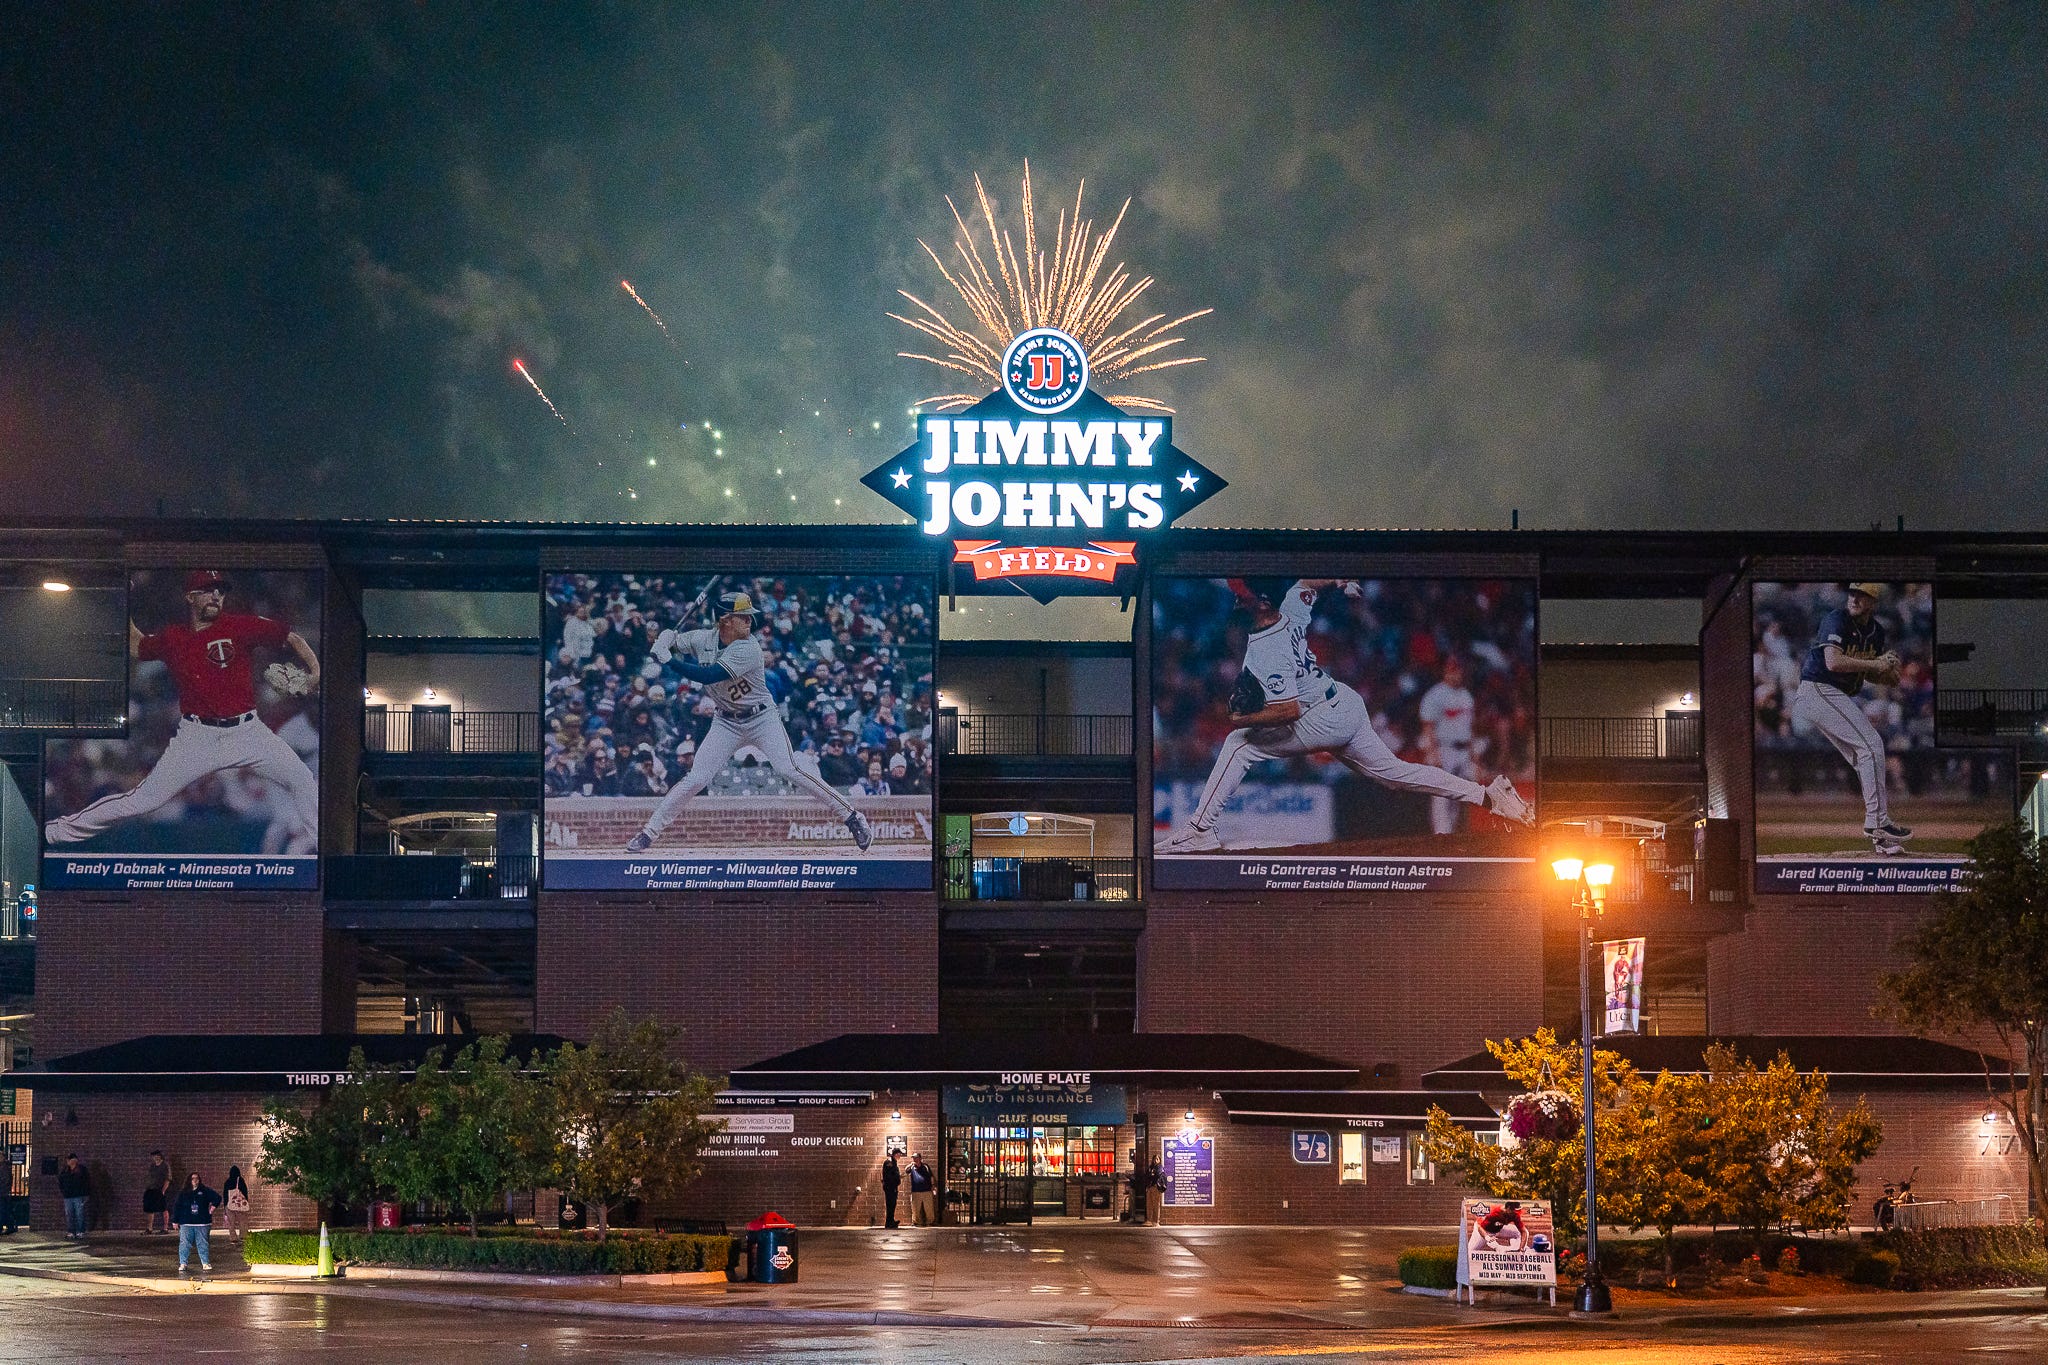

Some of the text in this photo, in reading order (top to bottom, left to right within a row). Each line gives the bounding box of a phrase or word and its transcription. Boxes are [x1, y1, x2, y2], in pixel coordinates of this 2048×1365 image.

[1027, 354, 1063, 390] JJ
[923, 419, 1162, 473] JIMMY
[923, 481, 1164, 535] JOHN'S
[1000, 553, 1091, 573] FIELD
[727, 678, 752, 701] 28
[1268, 679, 1284, 690] OXY
[787, 820, 853, 840] America
[66, 862, 110, 876] Randy
[113, 863, 166, 875] Dobnak
[179, 863, 251, 875] Minnesota
[254, 864, 295, 875] Twins
[624, 864, 657, 877] Joey
[661, 864, 713, 875] Wiemer
[726, 864, 798, 875] Milwaukee
[801, 864, 858, 875] Brewers
[1240, 864, 1268, 875] Luis
[1270, 864, 1337, 875] Contreras
[1350, 865, 1405, 876] Houston
[1408, 865, 1453, 877] Astros
[1777, 868, 1816, 879] Jared
[1819, 868, 1864, 881] Koenig
[1877, 868, 1947, 879] Milwaukee
[127, 879, 234, 888] Former Utica Unicorn
[647, 879, 835, 890] Former Birmingham Bloomfield Beaver
[1266, 880, 1427, 891] Former Eastside Diamond Hopper
[1800, 884, 1834, 892] Former
[1837, 884, 1894, 894] Birmingham
[286, 1074, 330, 1085] THIRD
[1001, 1073, 1091, 1084] HOME PLATE
[967, 1094, 1093, 1104] AUTO INSURANCE
[768, 1116, 792, 1126] Group
[1347, 1119, 1384, 1128] TICKETS
[709, 1135, 766, 1144] NOW HIRING
[791, 1137, 822, 1146] GROUP
[696, 1147, 779, 1157] 3dimensional.com
[1471, 1253, 1552, 1263] PROFESSIONAL BASEBALL
[1495, 1263, 1523, 1271] SUMMER
[1525, 1264, 1542, 1272] LONG
